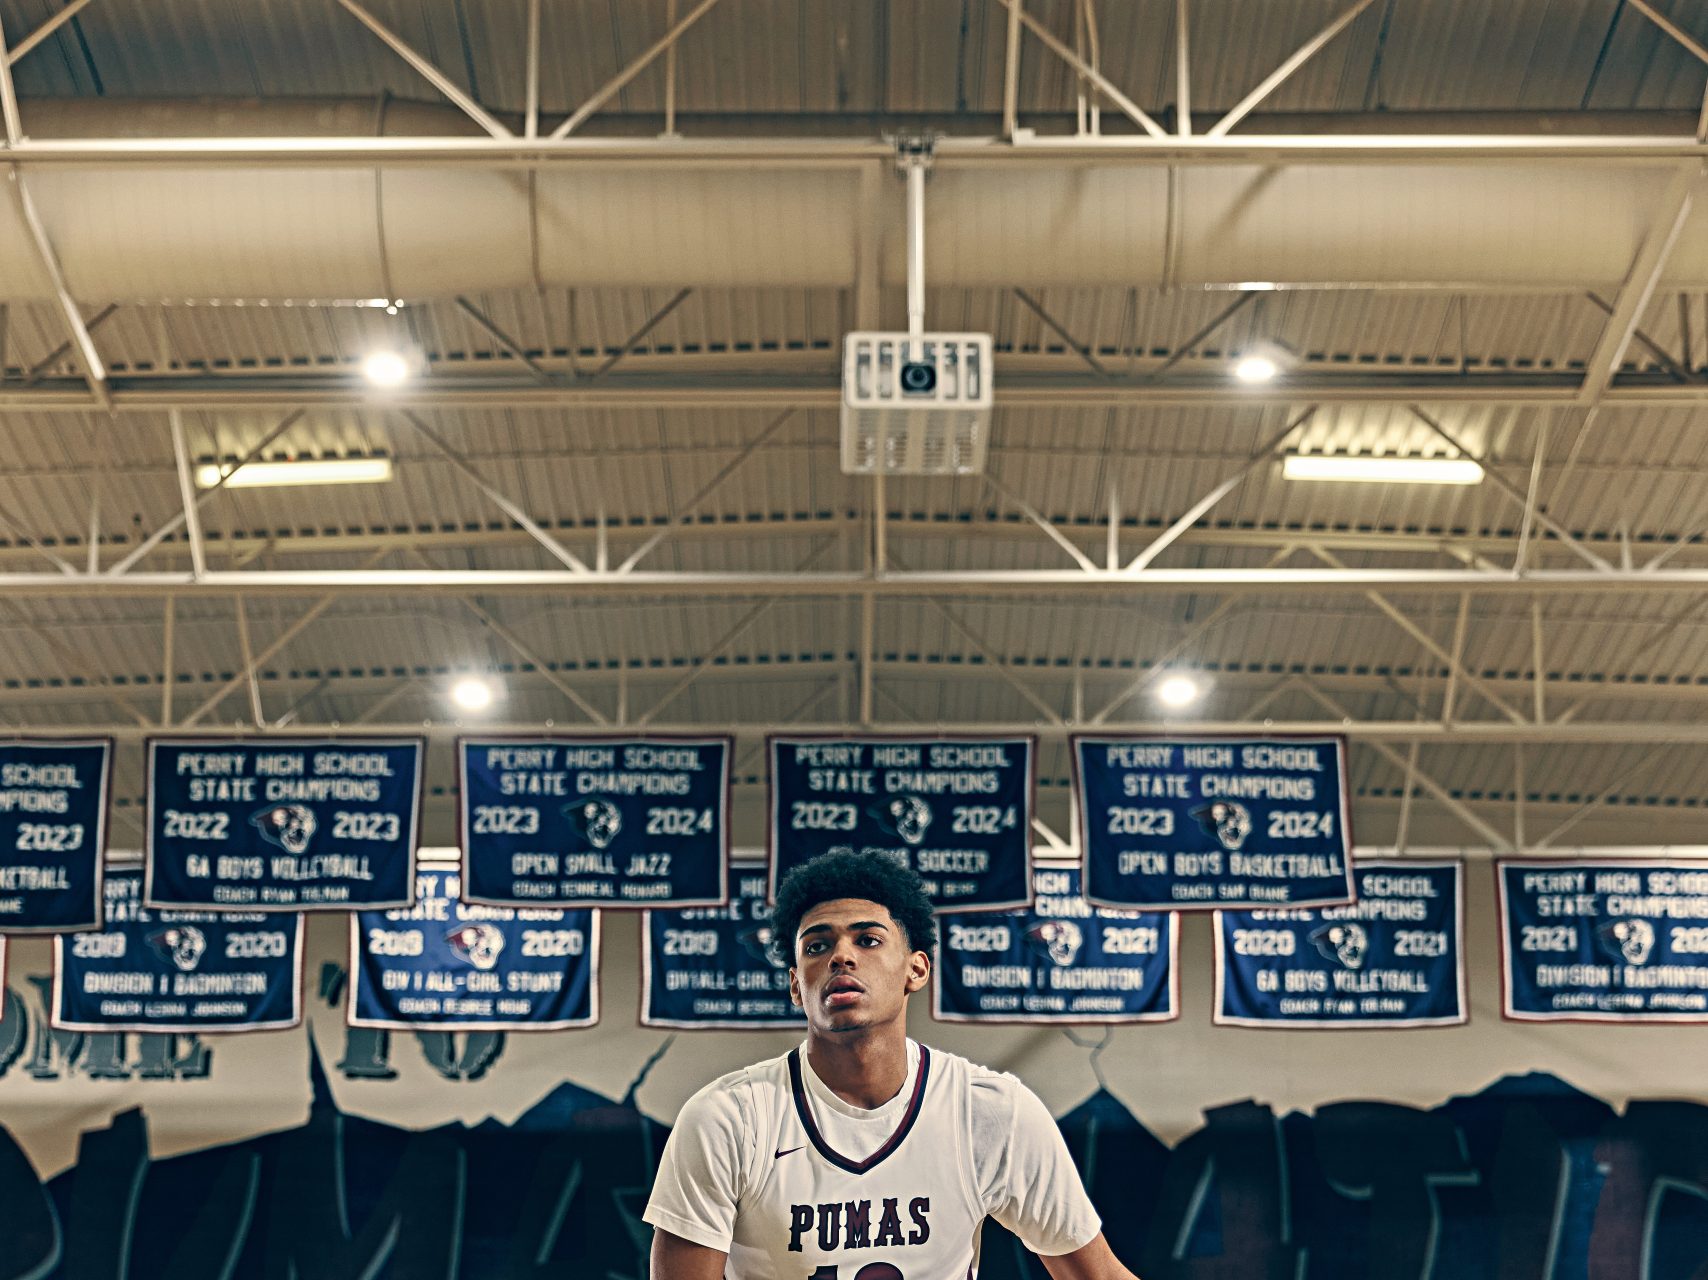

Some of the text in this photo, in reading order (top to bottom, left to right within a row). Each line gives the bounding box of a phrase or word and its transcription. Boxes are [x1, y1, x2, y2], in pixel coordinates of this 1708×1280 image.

[177, 753, 395, 777] PERRY HIGH SCHOOL
[487, 748, 705, 771] PERRY HIGH SCHOOL
[795, 747, 1012, 768] PERRY HIGH SCHOOL
[1107, 746, 1324, 772] PERRY HIGH SCHOOL
[2, 763, 81, 788] SCHOOL
[501, 772, 691, 796] STATE CHAMPIONS
[808, 769, 999, 794] STATE CHAMPIONS
[1123, 773, 1315, 801] STATE CHAMPIONS
[190, 778, 380, 802] STATE CHAMPIONS
[164, 810, 230, 840] 2022
[332, 811, 400, 841] 2023
[473, 806, 540, 835] 2023
[647, 807, 713, 836] 2024
[791, 801, 857, 830] 2023
[952, 805, 1017, 834] 2024
[1107, 806, 1174, 836] 2023
[1268, 810, 1334, 839] 2024
[16, 823, 83, 850] 2023
[186, 854, 210, 879] 6A
[217, 856, 264, 880] BOYS
[512, 853, 559, 876] OPEN
[624, 853, 672, 877] JAZZ
[917, 850, 989, 874] SOCCER
[1118, 850, 1344, 878] OPEN BOYS BASKETBALL
[1362, 874, 1438, 898] SCHOOL
[1524, 872, 1586, 894] PERRY
[1594, 872, 1641, 895] HIGH
[1537, 894, 1599, 917] STATE
[225, 931, 287, 958] 2020
[521, 929, 584, 957] 2020
[663, 930, 718, 956] 2019
[949, 925, 1011, 951] 2020
[1102, 926, 1159, 954] 2021
[1233, 929, 1296, 956] 2020
[1394, 930, 1448, 957] 2021
[1521, 925, 1578, 952] 2021
[507, 971, 563, 993] STUNT
[1256, 969, 1429, 993] 6A BOYS VOLLEYBALL
[1536, 964, 1611, 988] DIVISION
[788, 1197, 930, 1252] PUMAS
